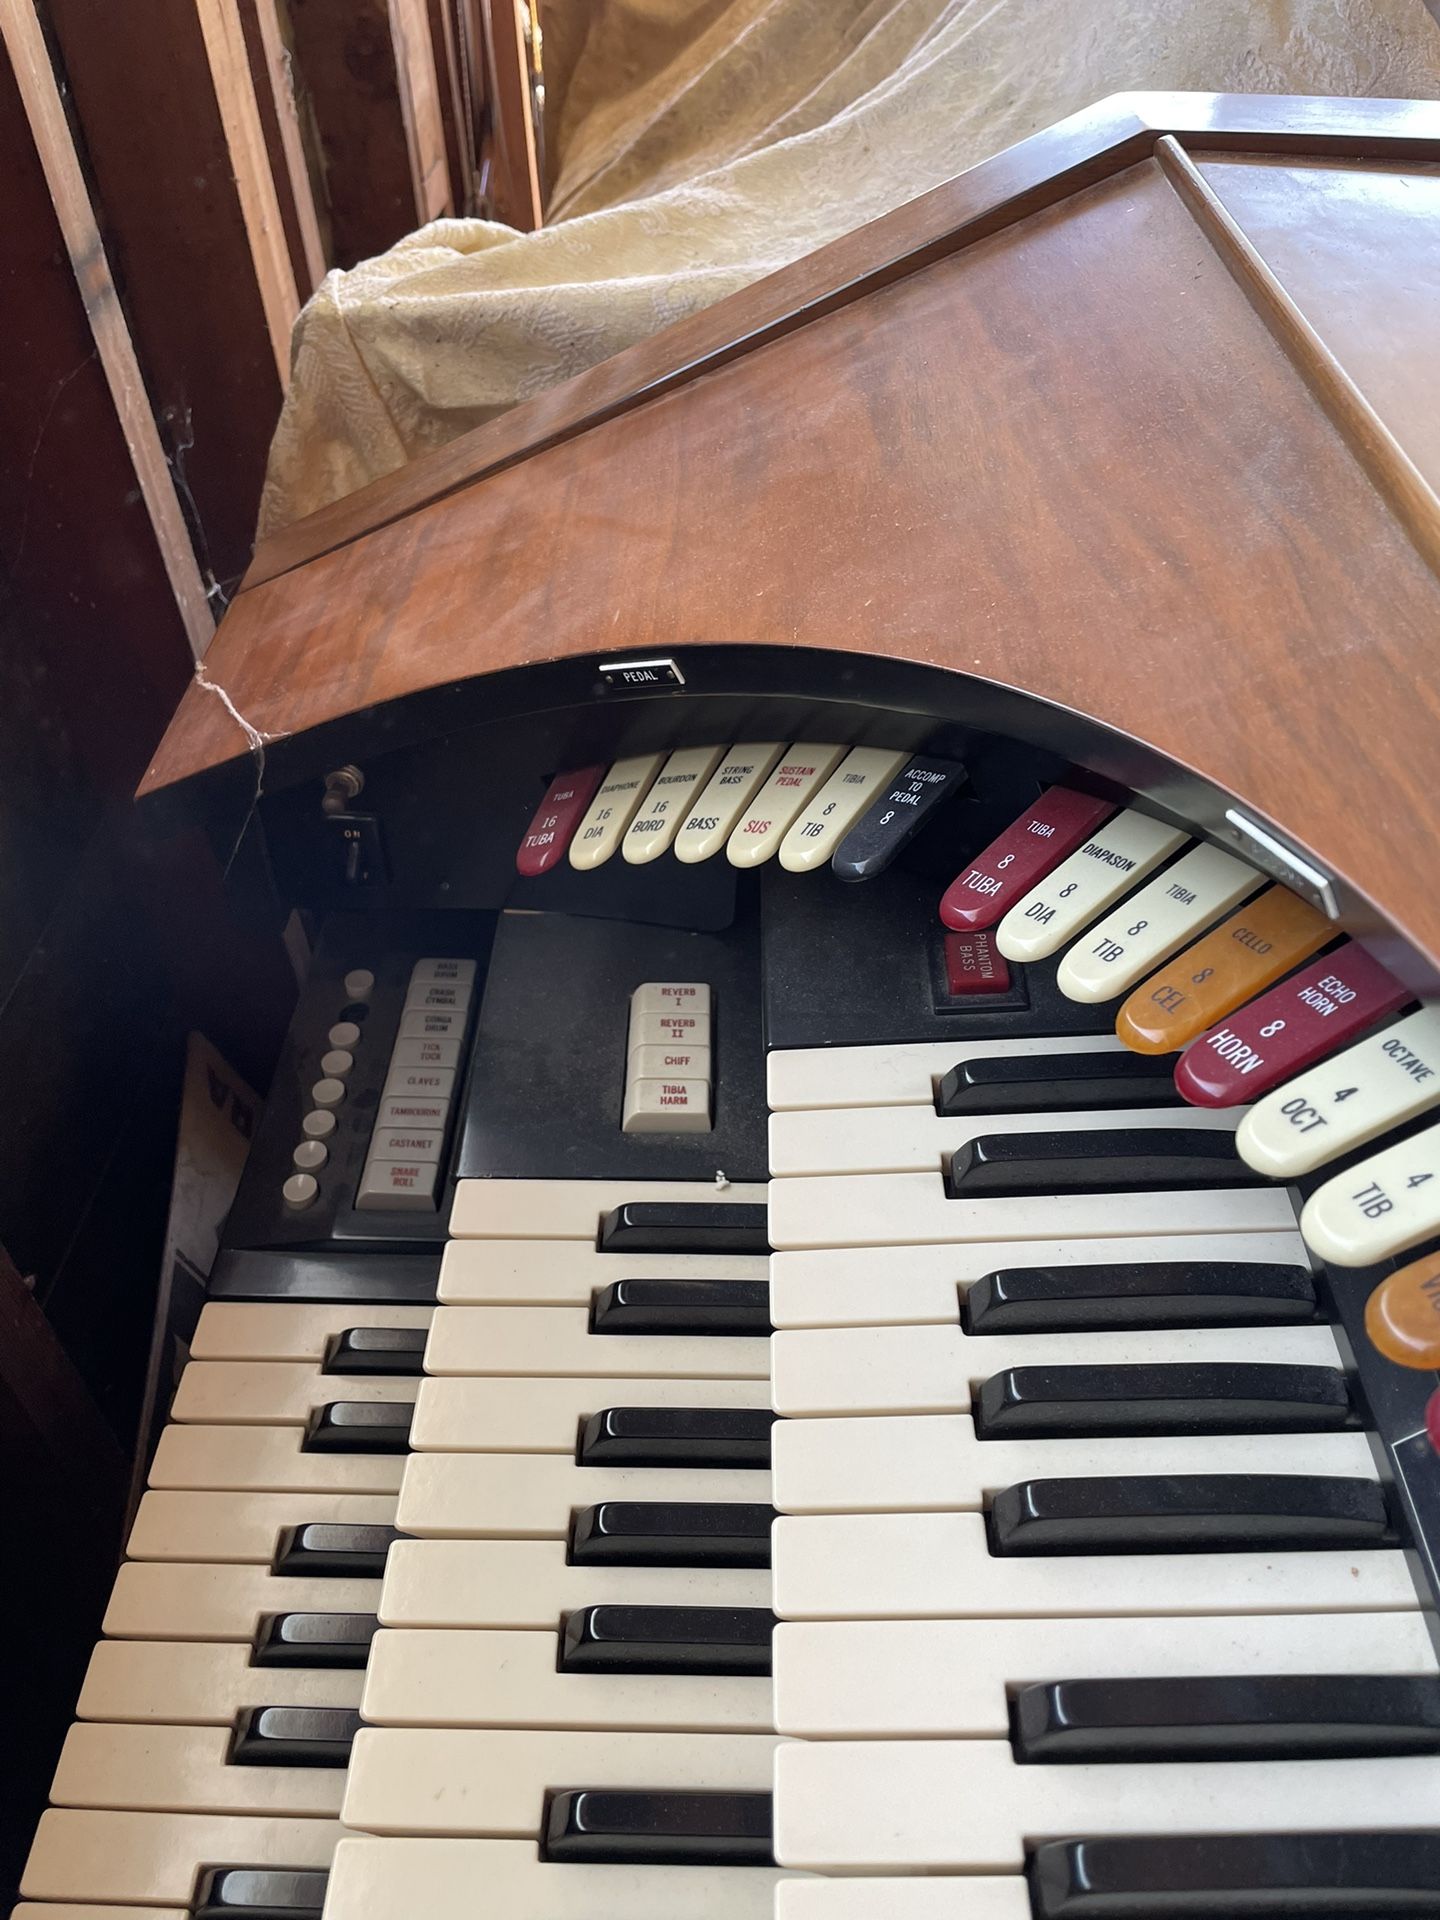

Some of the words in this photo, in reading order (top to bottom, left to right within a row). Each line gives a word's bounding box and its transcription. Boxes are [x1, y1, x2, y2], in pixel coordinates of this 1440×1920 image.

[623, 670, 659, 682] PEDAL
[722, 766, 754, 775] STRING
[779, 766, 816, 776] SUSTAIN
[904, 768, 946, 784] ACCOMP
[657, 773, 698, 786] BOURDON
[719, 776, 743, 785] BASS
[775, 776, 802, 787] PEDAL
[842, 773, 866, 785] TIBIA
[908, 781, 923, 792] TO
[553, 789, 574, 801] TUBA
[889, 790, 922, 806] PEDAL
[596, 808, 613, 821] 16
[651, 801, 669, 814] 16
[822, 802, 836, 816] 8
[542, 815, 558, 829] 16
[686, 817, 720, 830] BASS
[879, 810, 895, 825] 8
[583, 826, 604, 840] DIA
[632, 819, 665, 833] BORD
[743, 819, 772, 834] SUS
[800, 821, 825, 837] TIB
[1026, 820, 1056, 839] TUBA
[525, 831, 555, 848] TUBA
[997, 854, 1016, 870] 8
[1082, 843, 1137, 872] DIAPASON
[962, 870, 1004, 897] TUBA
[1059, 883, 1078, 898] 8
[1165, 883, 1198, 906] TIBIA
[1024, 902, 1056, 925] DIA
[1127, 920, 1148, 936] 8
[1232, 927, 1273, 955] CELLO
[974, 933, 995, 979] PHANTOM
[1092, 937, 1124, 963] TIB
[960, 945, 976, 971] BASS
[1191, 967, 1215, 985] 8
[661, 988, 696, 997] REVERB
[1317, 975, 1357, 1004] ECHO
[1151, 985, 1187, 1016] CEL
[1297, 986, 1339, 1018] HORN
[660, 1019, 695, 1028] REVERB
[1259, 1019, 1287, 1038] 8
[671, 1029, 683, 1038] II
[1206, 1028, 1265, 1075] HORN
[664, 1056, 690, 1065] CHIFF
[1381, 1038, 1435, 1084] OCTAVE
[407, 1076, 440, 1086] CLAVES
[662, 1085, 687, 1095] TIBIA
[1333, 1086, 1359, 1103] 4
[660, 1096, 687, 1105] HARM
[1280, 1097, 1328, 1134] OCT
[389, 1139, 433, 1149] CASTANET
[1406, 1172, 1434, 1189] 4
[1352, 1181, 1393, 1219] TIB
